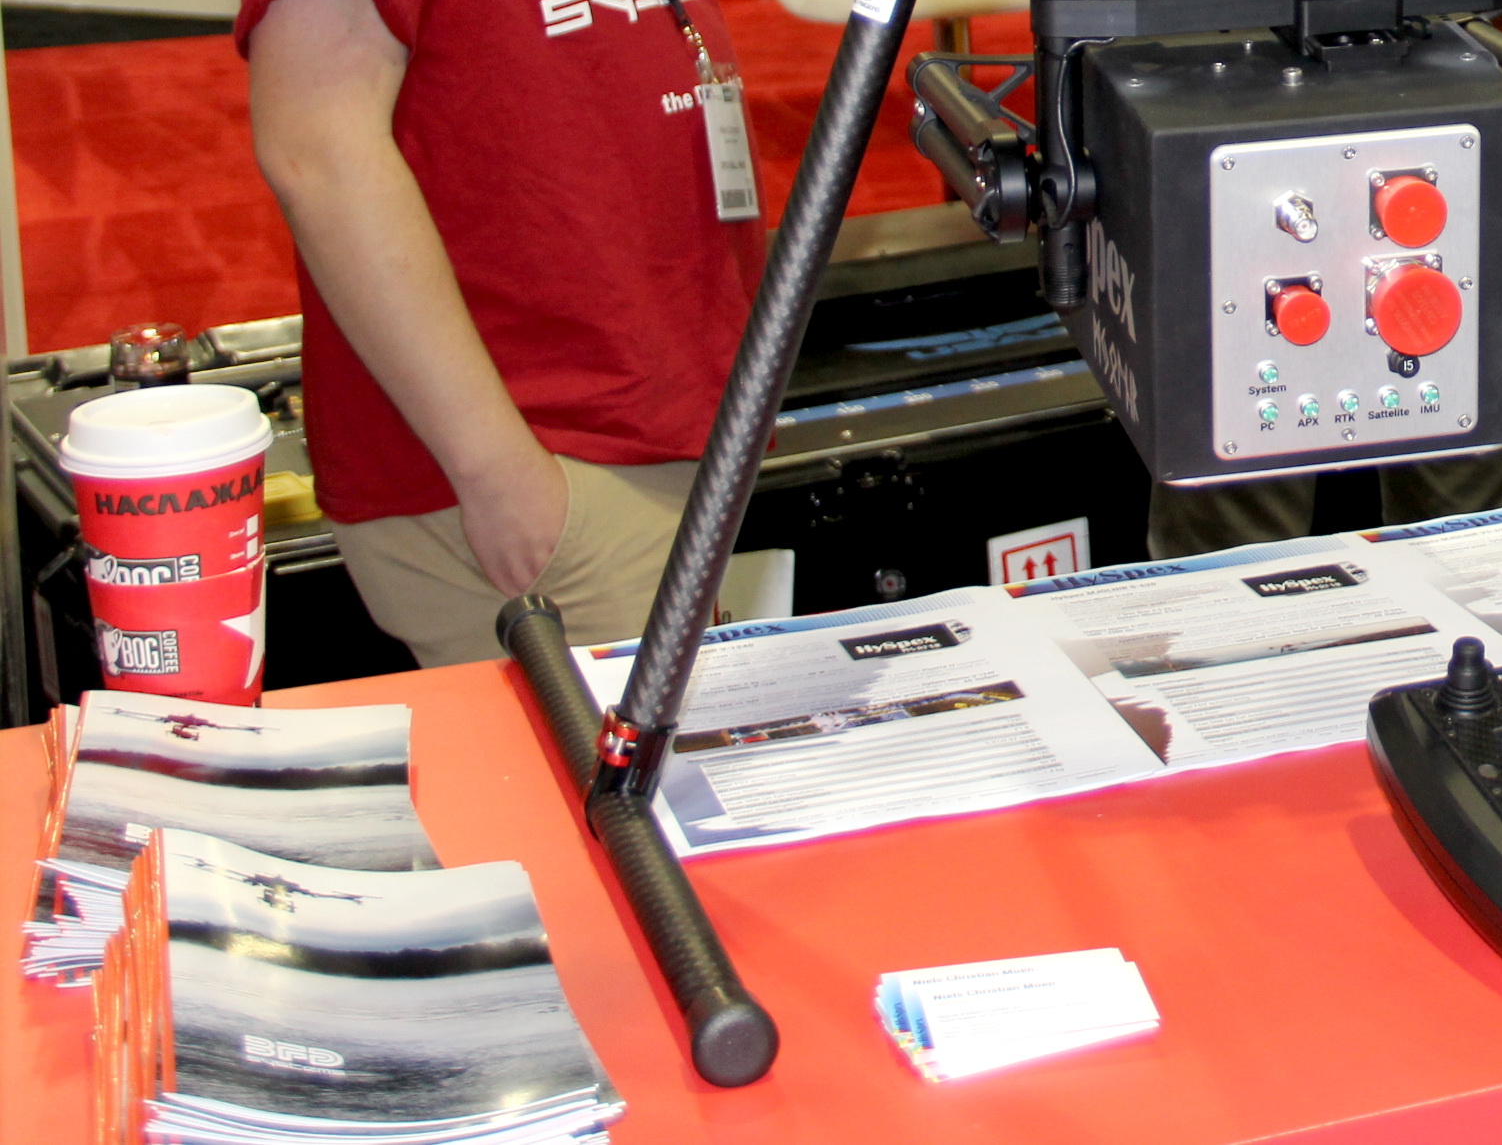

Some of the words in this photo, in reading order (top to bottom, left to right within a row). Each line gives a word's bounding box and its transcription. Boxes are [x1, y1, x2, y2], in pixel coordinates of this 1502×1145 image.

[662, 91, 695, 114] the
[1248, 383, 1287, 396] System
[1368, 407, 1410, 420] Sattelite
[1420, 405, 1441, 415] IMU
[1260, 422, 1276, 432] PC
[1298, 417, 1319, 428] APX
[1334, 414, 1356, 424] RTK
[1051, 563, 1188, 590] HySpex
[121, 636, 160, 670] BOG
[162, 629, 179, 674] COFFEE
[855, 634, 938, 655] HySpex
[244, 1034, 346, 1069] BFD
